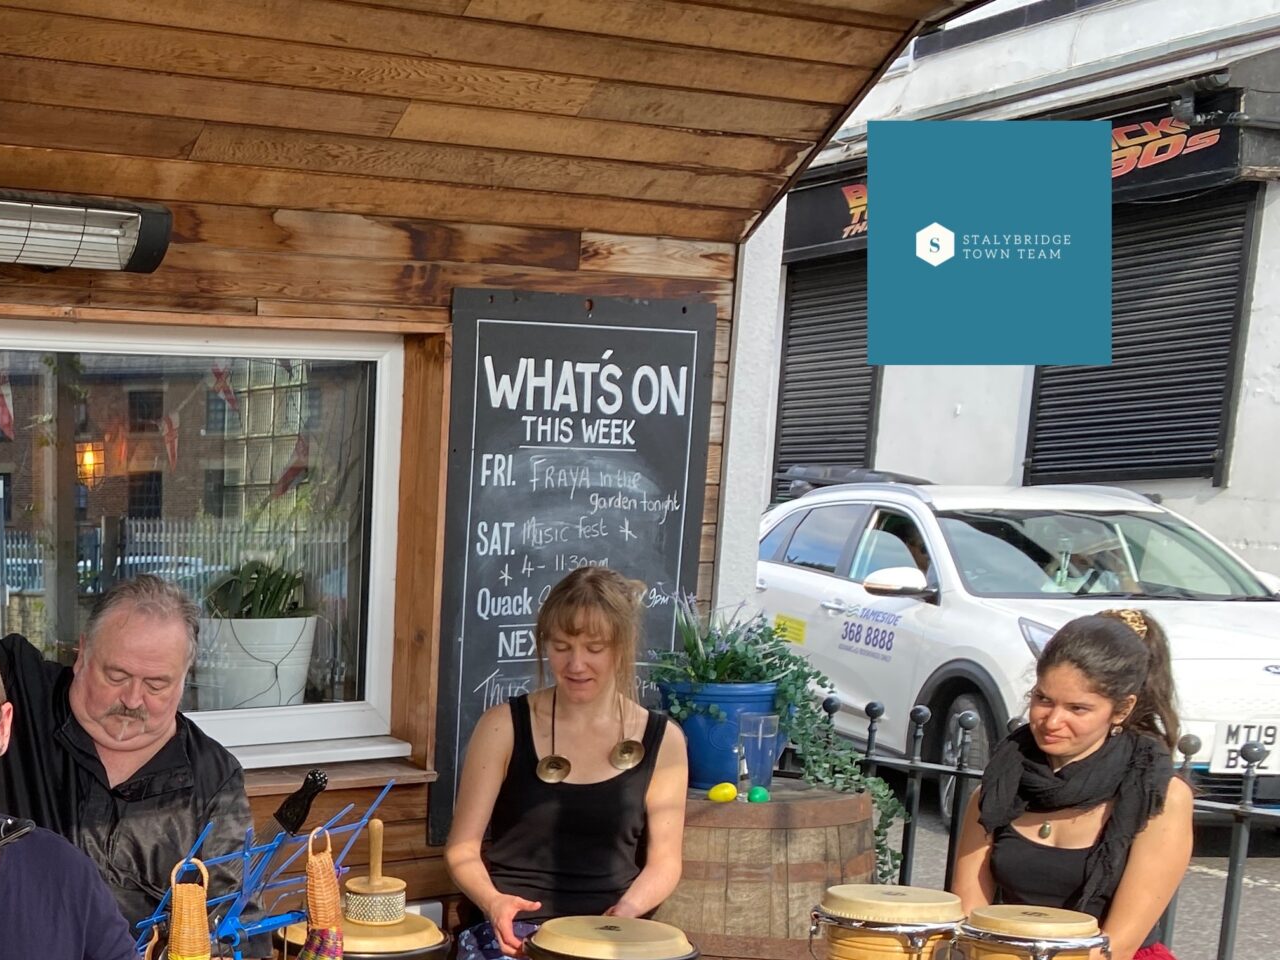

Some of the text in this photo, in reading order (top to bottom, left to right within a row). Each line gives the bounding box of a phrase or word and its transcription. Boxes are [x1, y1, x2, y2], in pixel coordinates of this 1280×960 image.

[632, 365, 687, 416] ON
[522, 415, 636, 445] THIS WEEK
[481, 454, 516, 487] FRI.
[589, 490, 680, 525] garden tonight
[476, 522, 516, 556] SAT.
[476, 587, 532, 620] Quack
[841, 621, 895, 651] 368 8888
[1225, 724, 1277, 746] MT19
